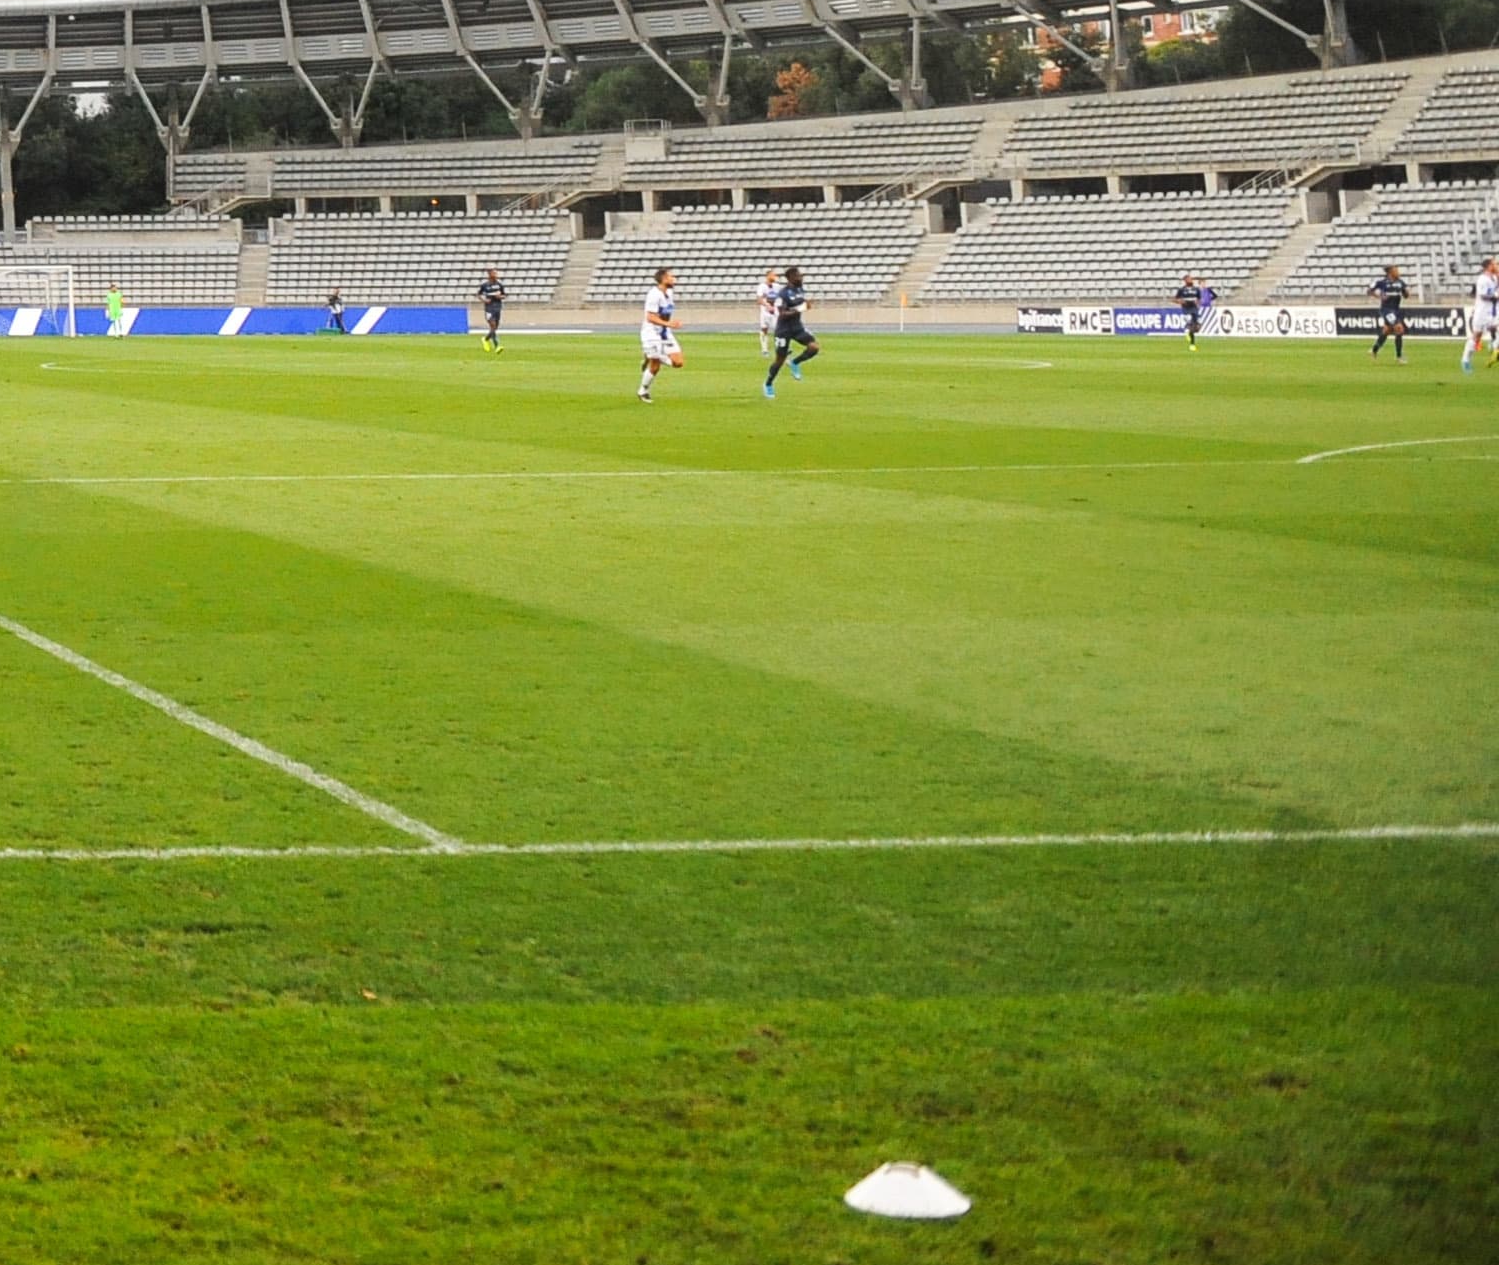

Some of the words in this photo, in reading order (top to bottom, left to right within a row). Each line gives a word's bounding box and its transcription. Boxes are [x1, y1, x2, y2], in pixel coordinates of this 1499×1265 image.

[1069, 311, 1098, 331] RMC
[1116, 313, 1162, 329] GROUPE
[1338, 317, 1377, 329] VINCI
[1403, 317, 1444, 329] VINCI
